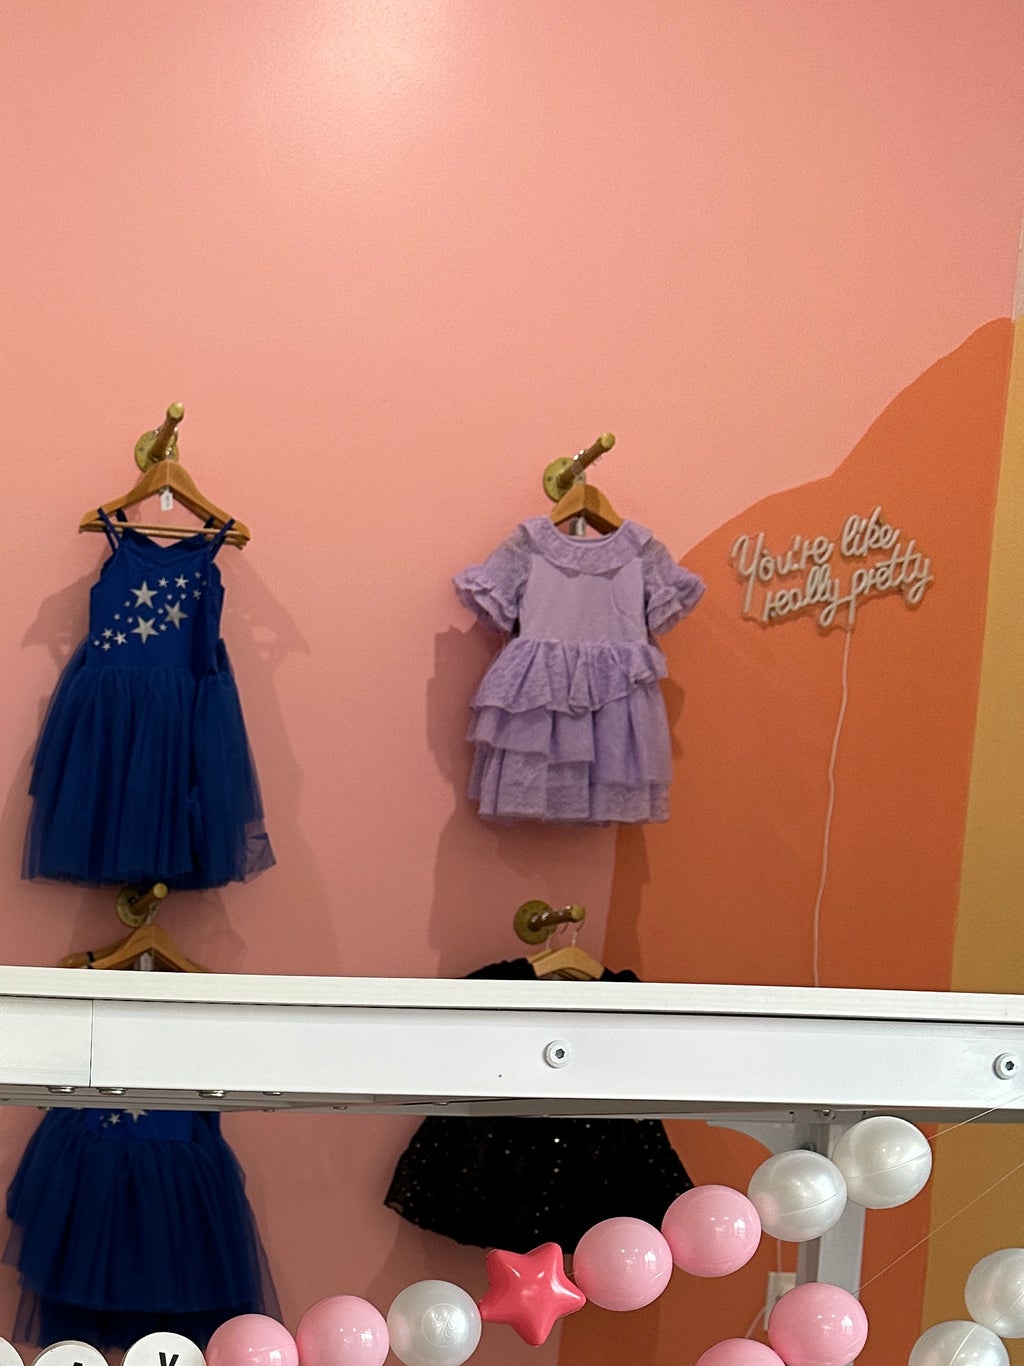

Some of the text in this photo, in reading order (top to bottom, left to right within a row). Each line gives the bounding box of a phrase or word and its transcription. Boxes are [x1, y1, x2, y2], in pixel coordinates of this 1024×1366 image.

[730, 506, 901, 614] You're like
[762, 539, 933, 627] really pretty
